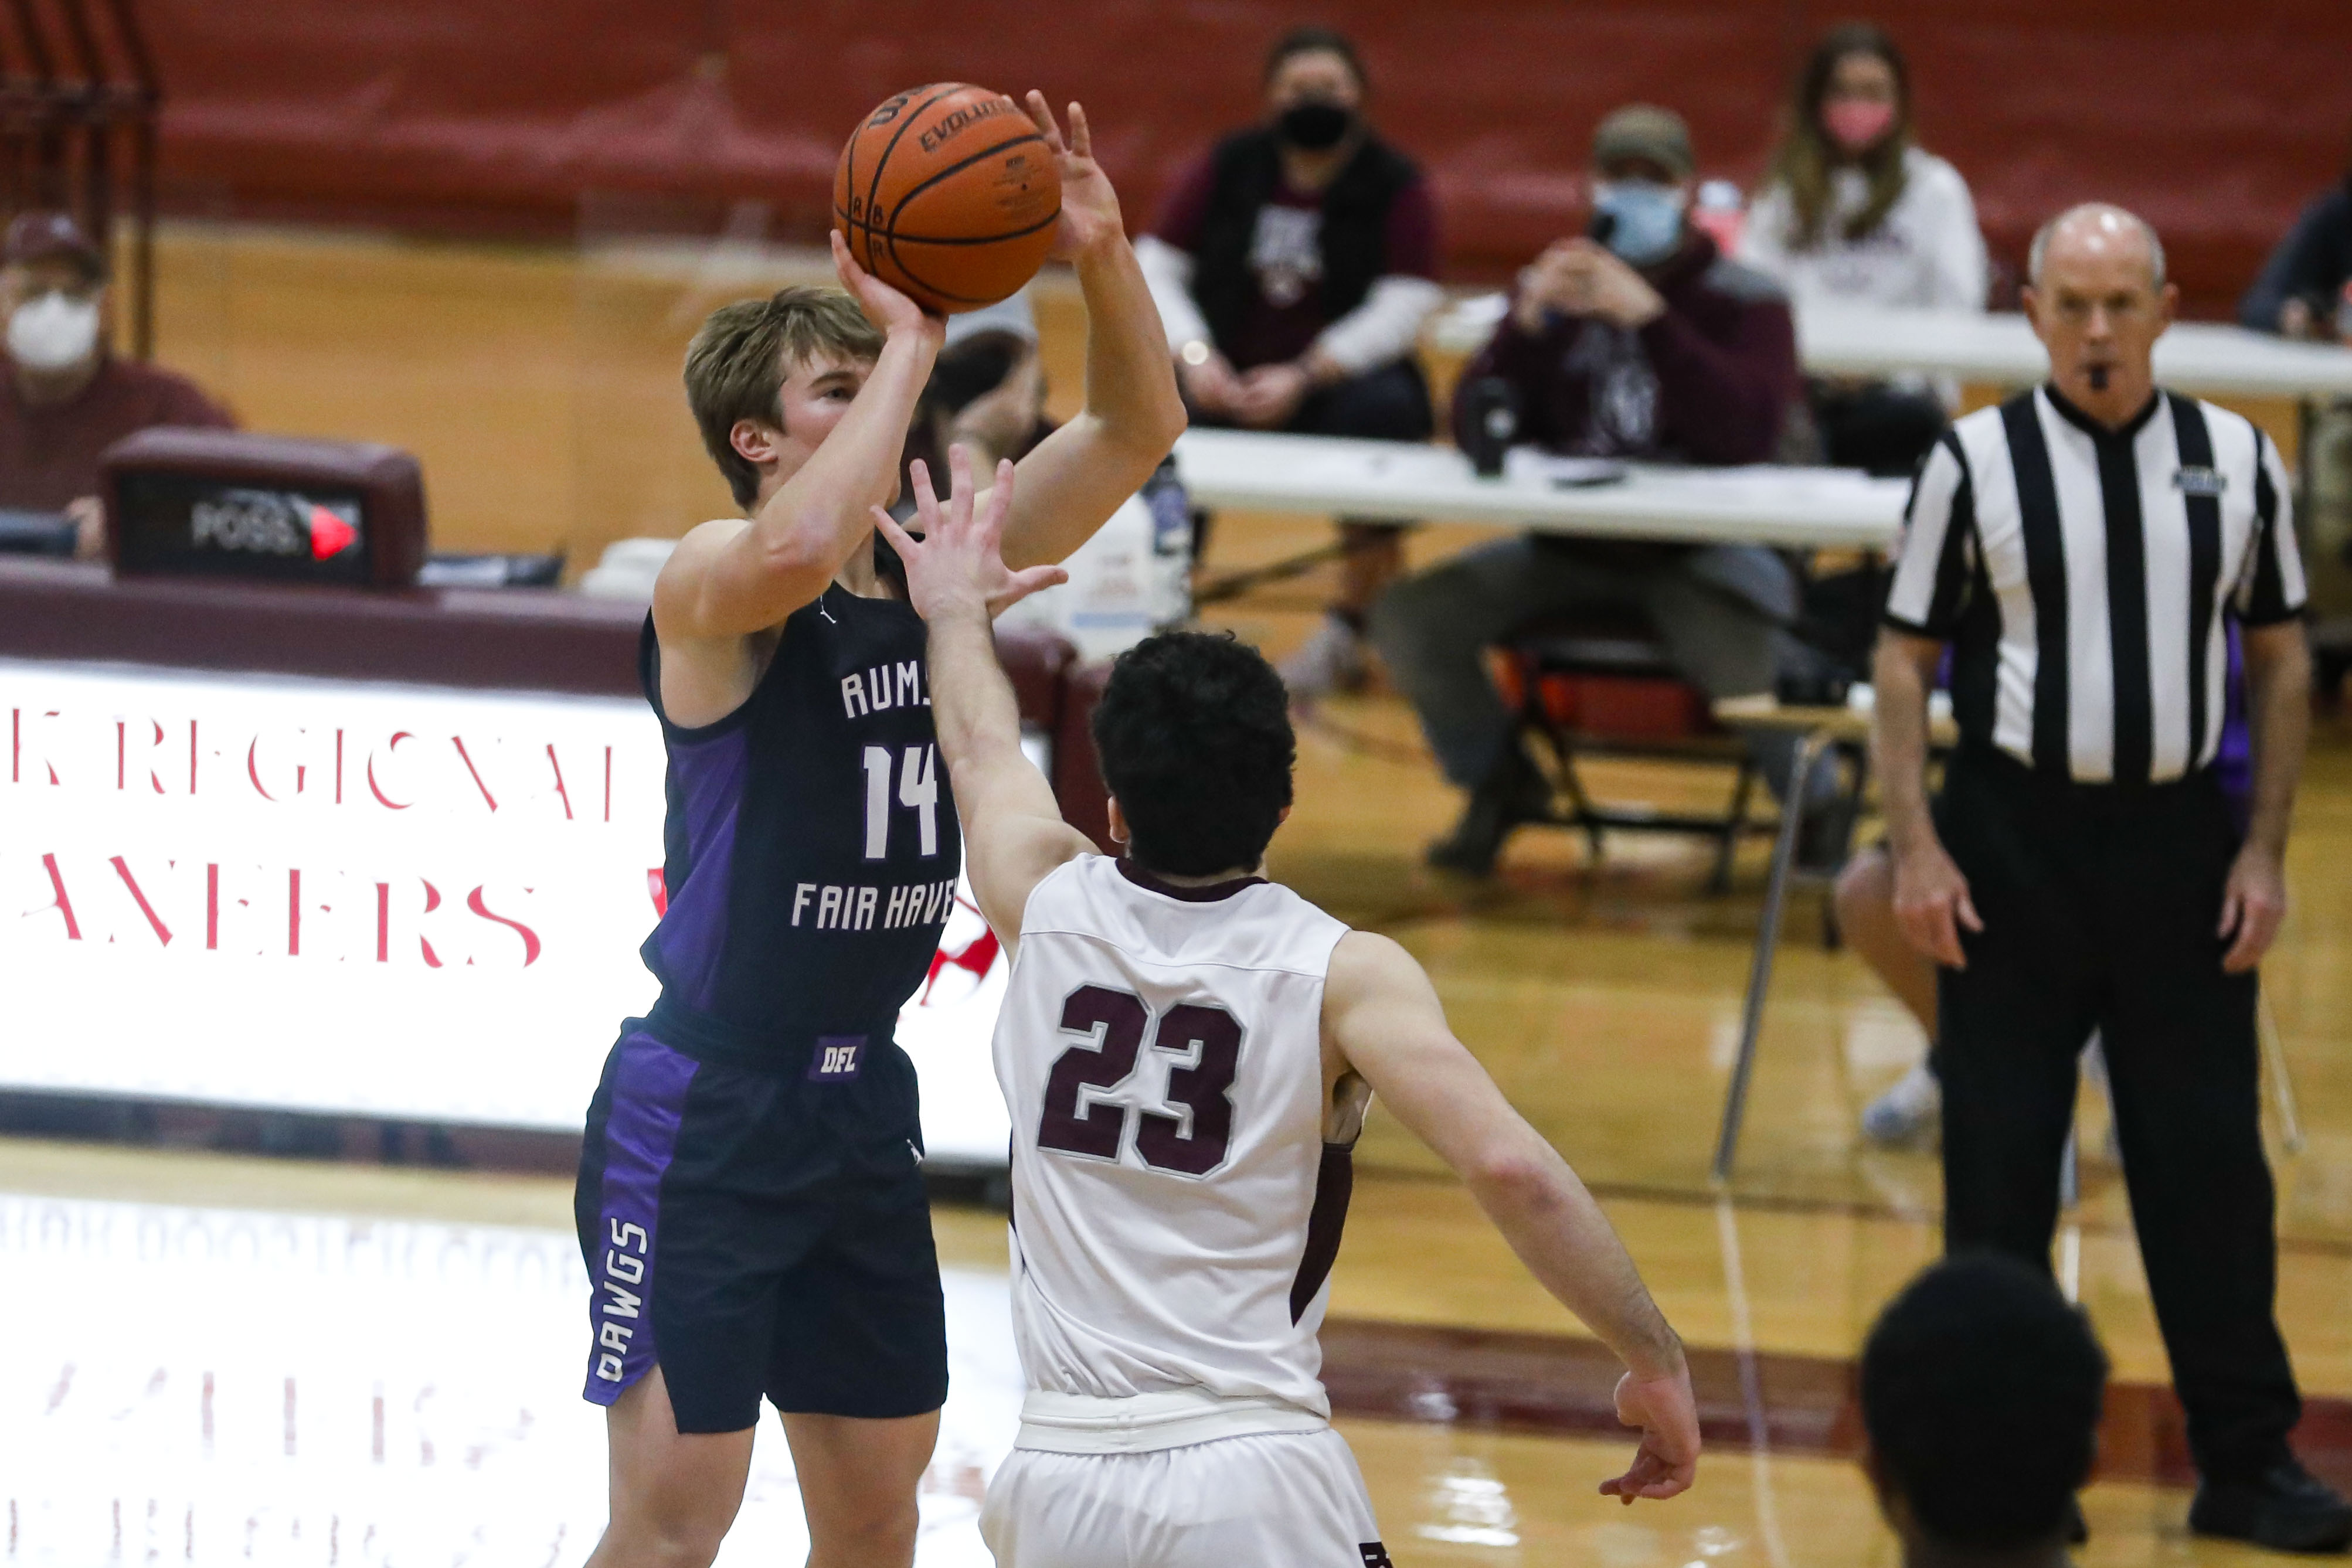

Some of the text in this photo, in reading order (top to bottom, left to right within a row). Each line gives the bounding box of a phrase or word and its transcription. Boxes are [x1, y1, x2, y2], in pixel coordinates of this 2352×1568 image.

[864, 743, 938, 860] 14
[791, 882, 879, 931] FAIR
[1037, 979, 1248, 1181] 23
[595, 1217, 648, 1383] DAWGS
